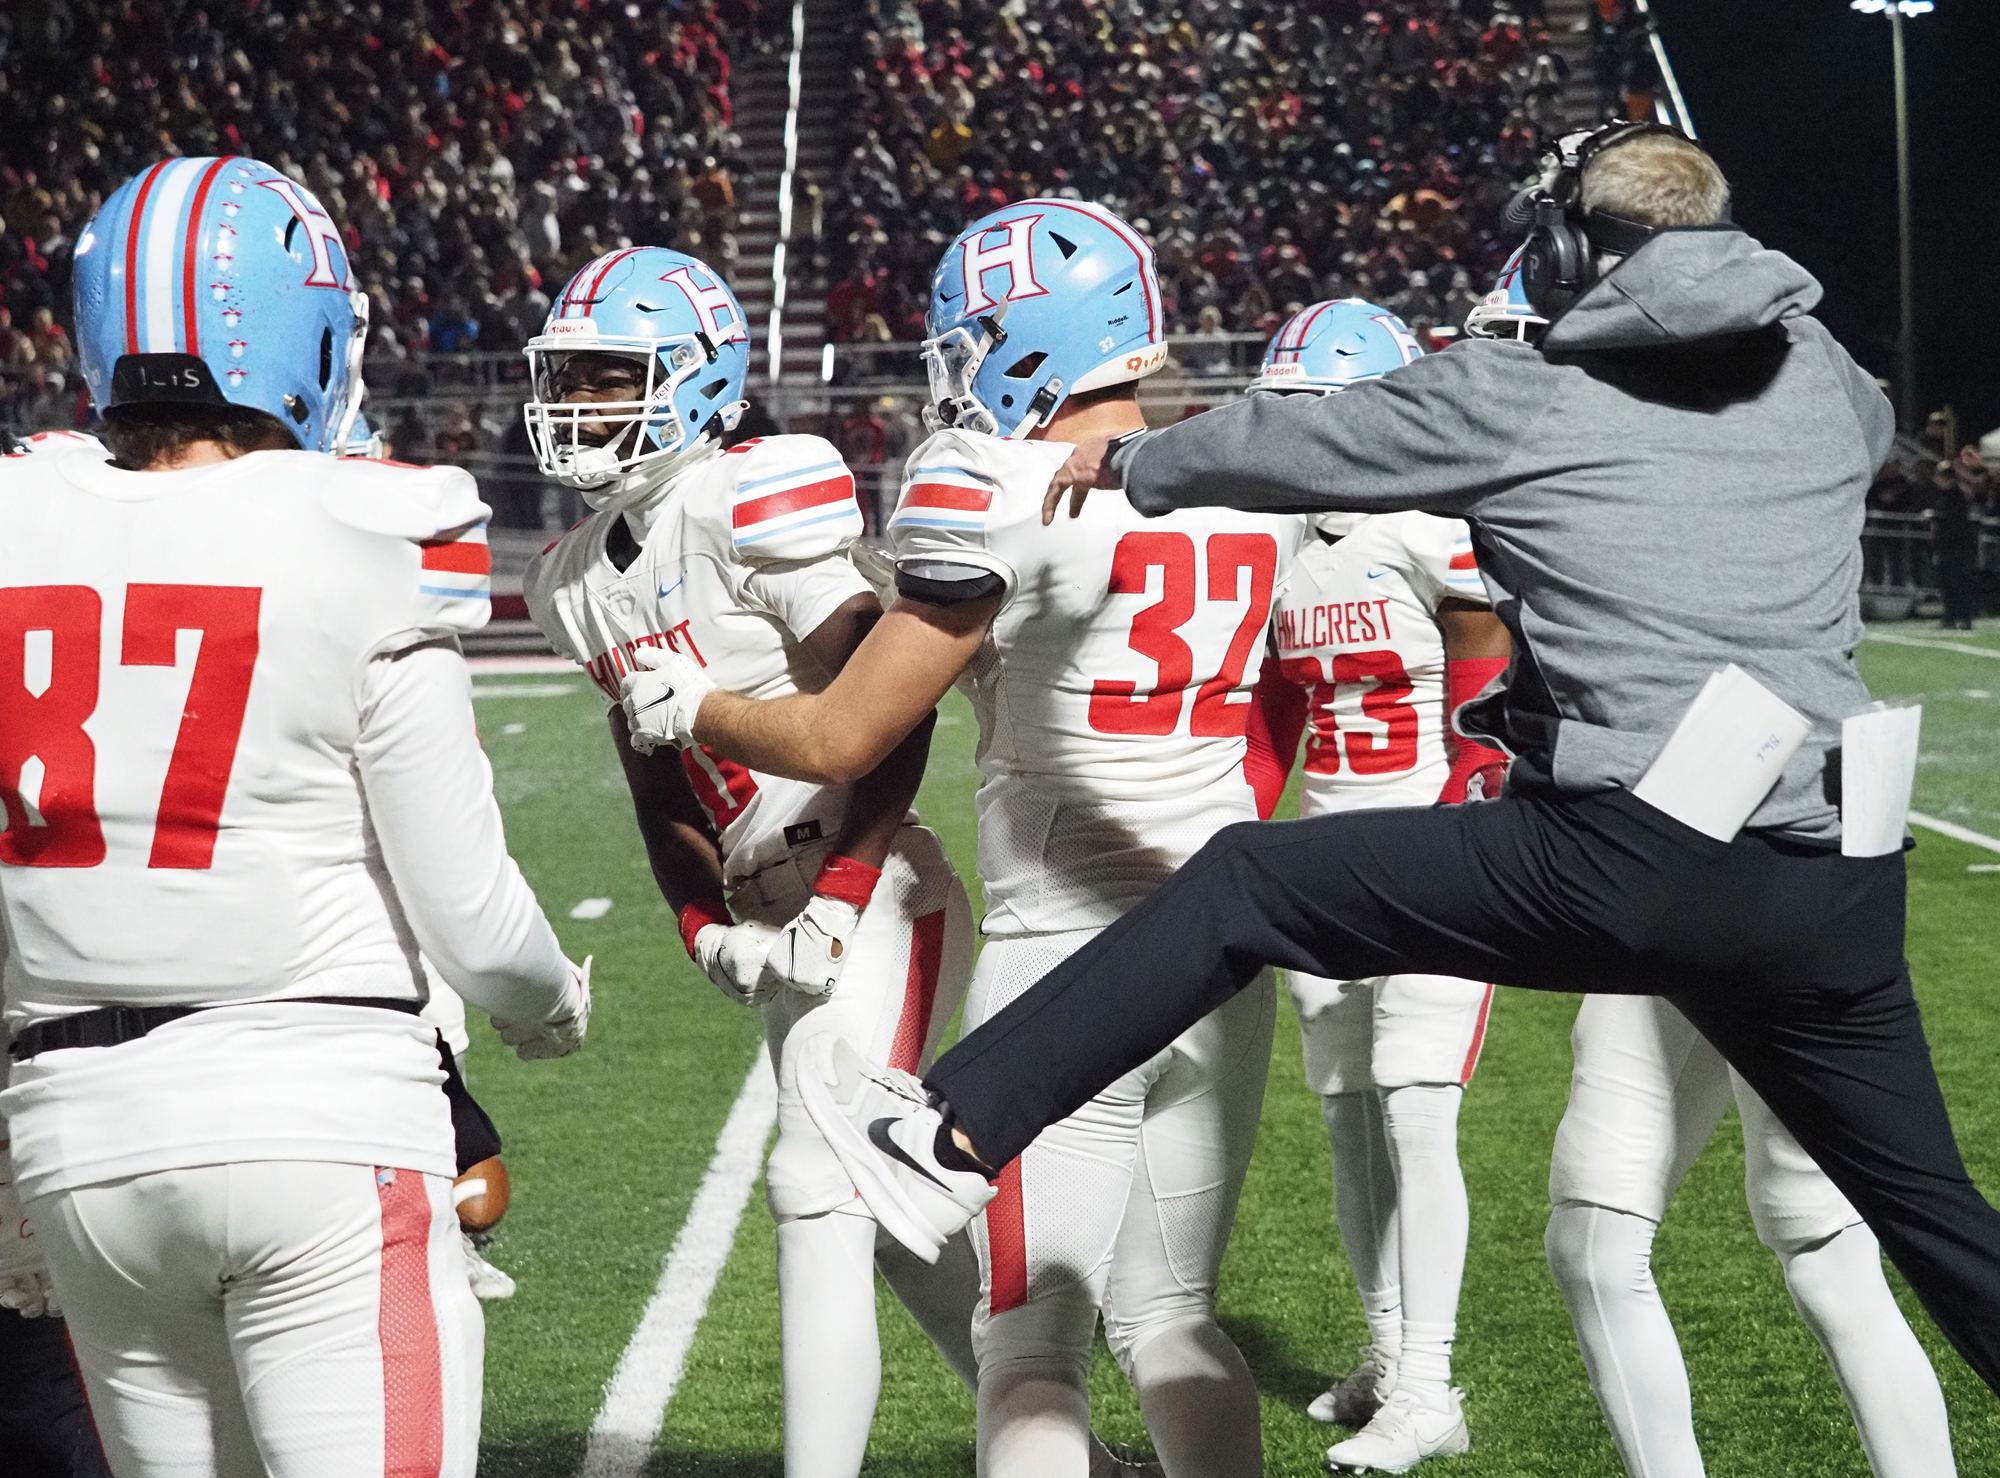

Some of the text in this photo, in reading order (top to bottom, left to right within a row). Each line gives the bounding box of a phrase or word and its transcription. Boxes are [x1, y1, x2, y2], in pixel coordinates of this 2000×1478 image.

[959, 213, 1050, 318] H
[658, 265, 748, 342] H
[1098, 335, 1116, 353] 32
[1266, 366, 1297, 376] Riddell
[1088, 531, 1278, 738] 32
[1277, 597, 1392, 651] HILLCREST
[0, 583, 263, 869] 87
[796, 828, 810, 840] M
